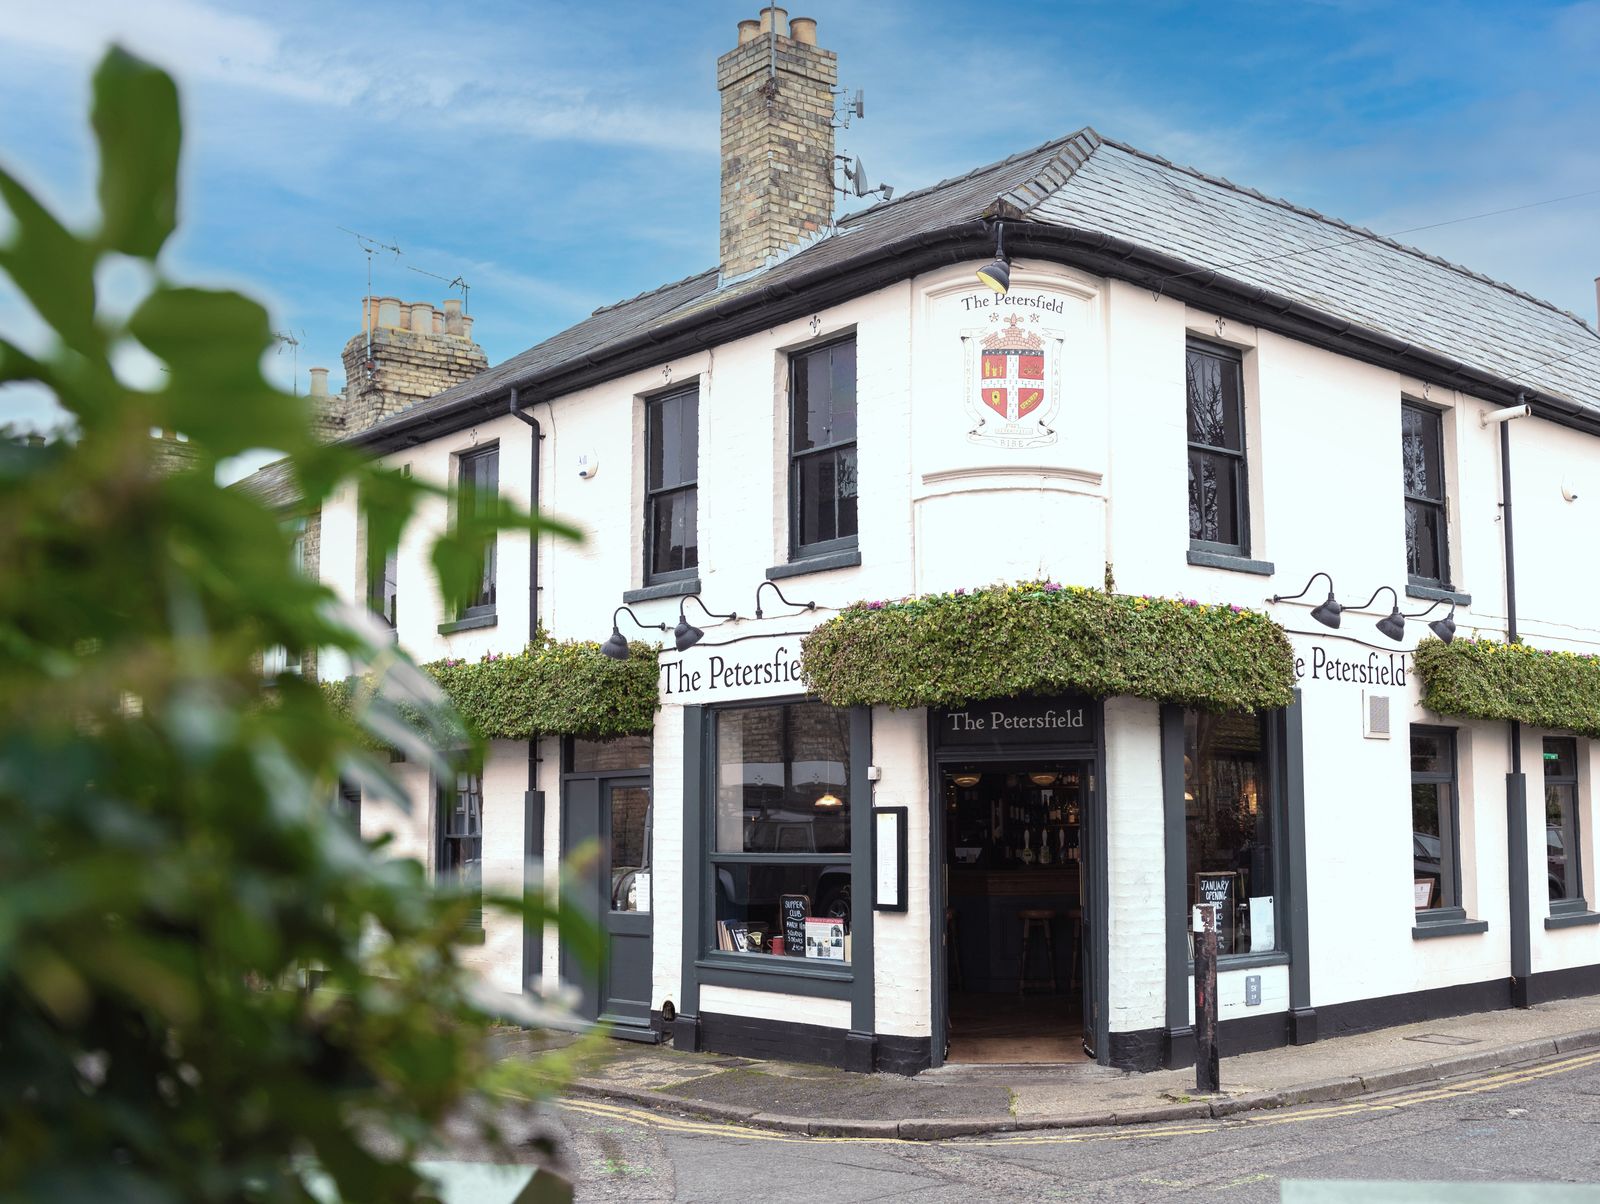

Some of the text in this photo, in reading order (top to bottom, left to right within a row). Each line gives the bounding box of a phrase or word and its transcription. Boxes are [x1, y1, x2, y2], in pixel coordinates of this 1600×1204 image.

[961, 292, 1064, 314] The Petersfield
[660, 646, 802, 695] The Petersfie
[1311, 646, 1407, 687] Petersfield
[947, 709, 1084, 731] The Petersfield
[1201, 880, 1229, 893] JANUARY
[784, 900, 805, 910] SUPPER
